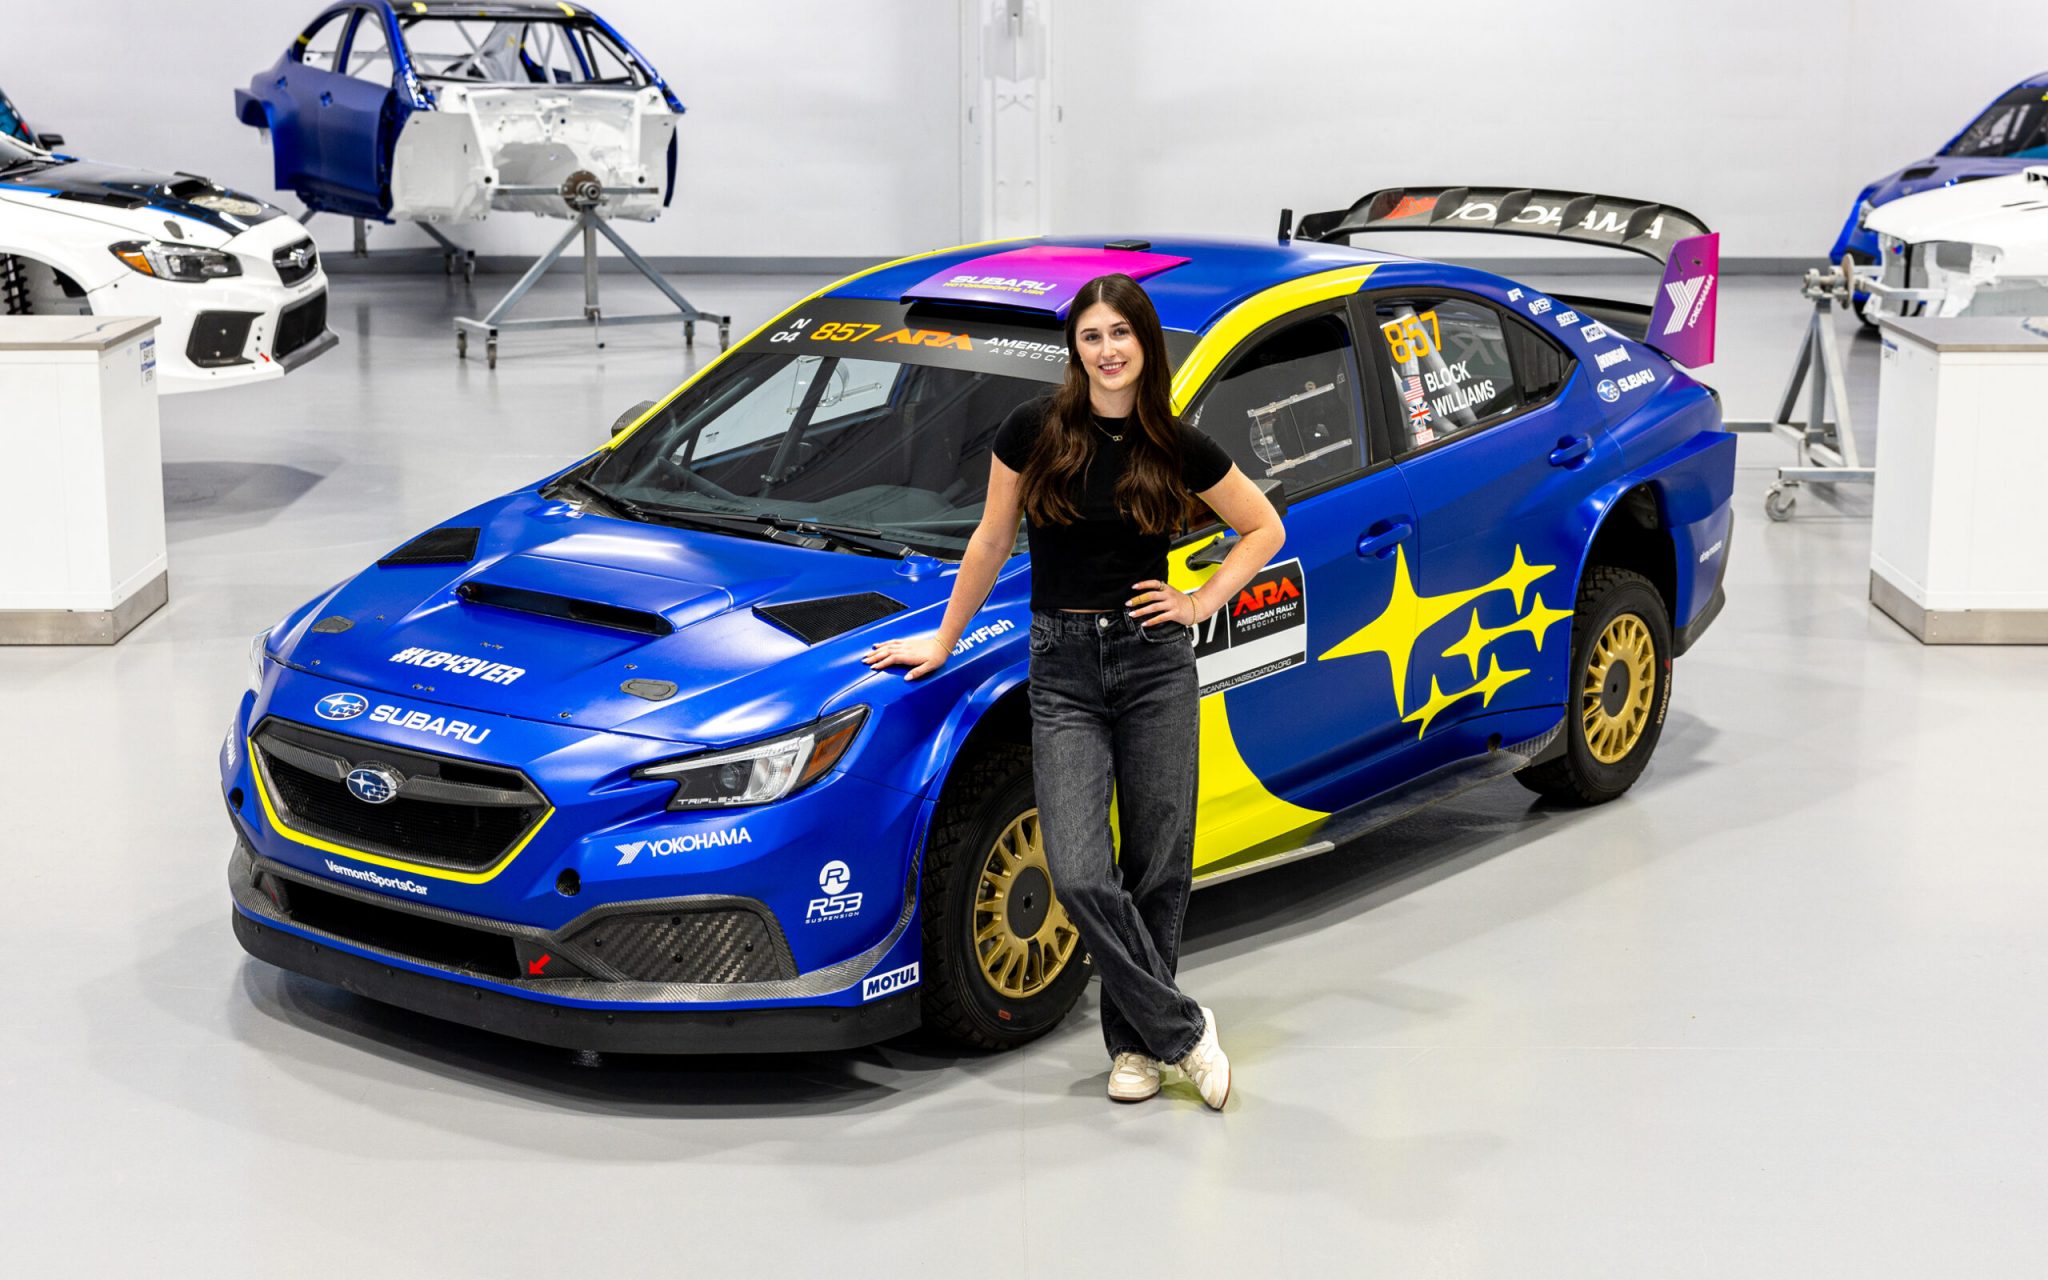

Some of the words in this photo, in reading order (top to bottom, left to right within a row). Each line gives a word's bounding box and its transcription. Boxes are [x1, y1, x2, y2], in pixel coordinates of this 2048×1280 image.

[950, 275, 1058, 291] SUBARU
[770, 331, 800, 343] 04
[789, 318, 812, 329] N
[810, 322, 882, 342] 857
[873, 328, 973, 351] ARA
[1383, 309, 1441, 363] 857
[1424, 360, 1471, 393] BLOCK
[1617, 369, 1656, 392] SUBARU
[1432, 380, 1496, 417] WILLIAMS
[1232, 576, 1300, 617] ARA
[1236, 610, 1275, 628] AMERICAN
[1275, 602, 1298, 614] RALLY
[388, 646, 526, 686] #KB43VER
[369, 704, 492, 745] SUBARU
[647, 827, 752, 857] YOKOHAMA
[324, 858, 428, 896] VermontSportsCar
[805, 911, 860, 924] SUSPENSION
[806, 892, 863, 918] R53
[866, 966, 917, 997] MOTUL
